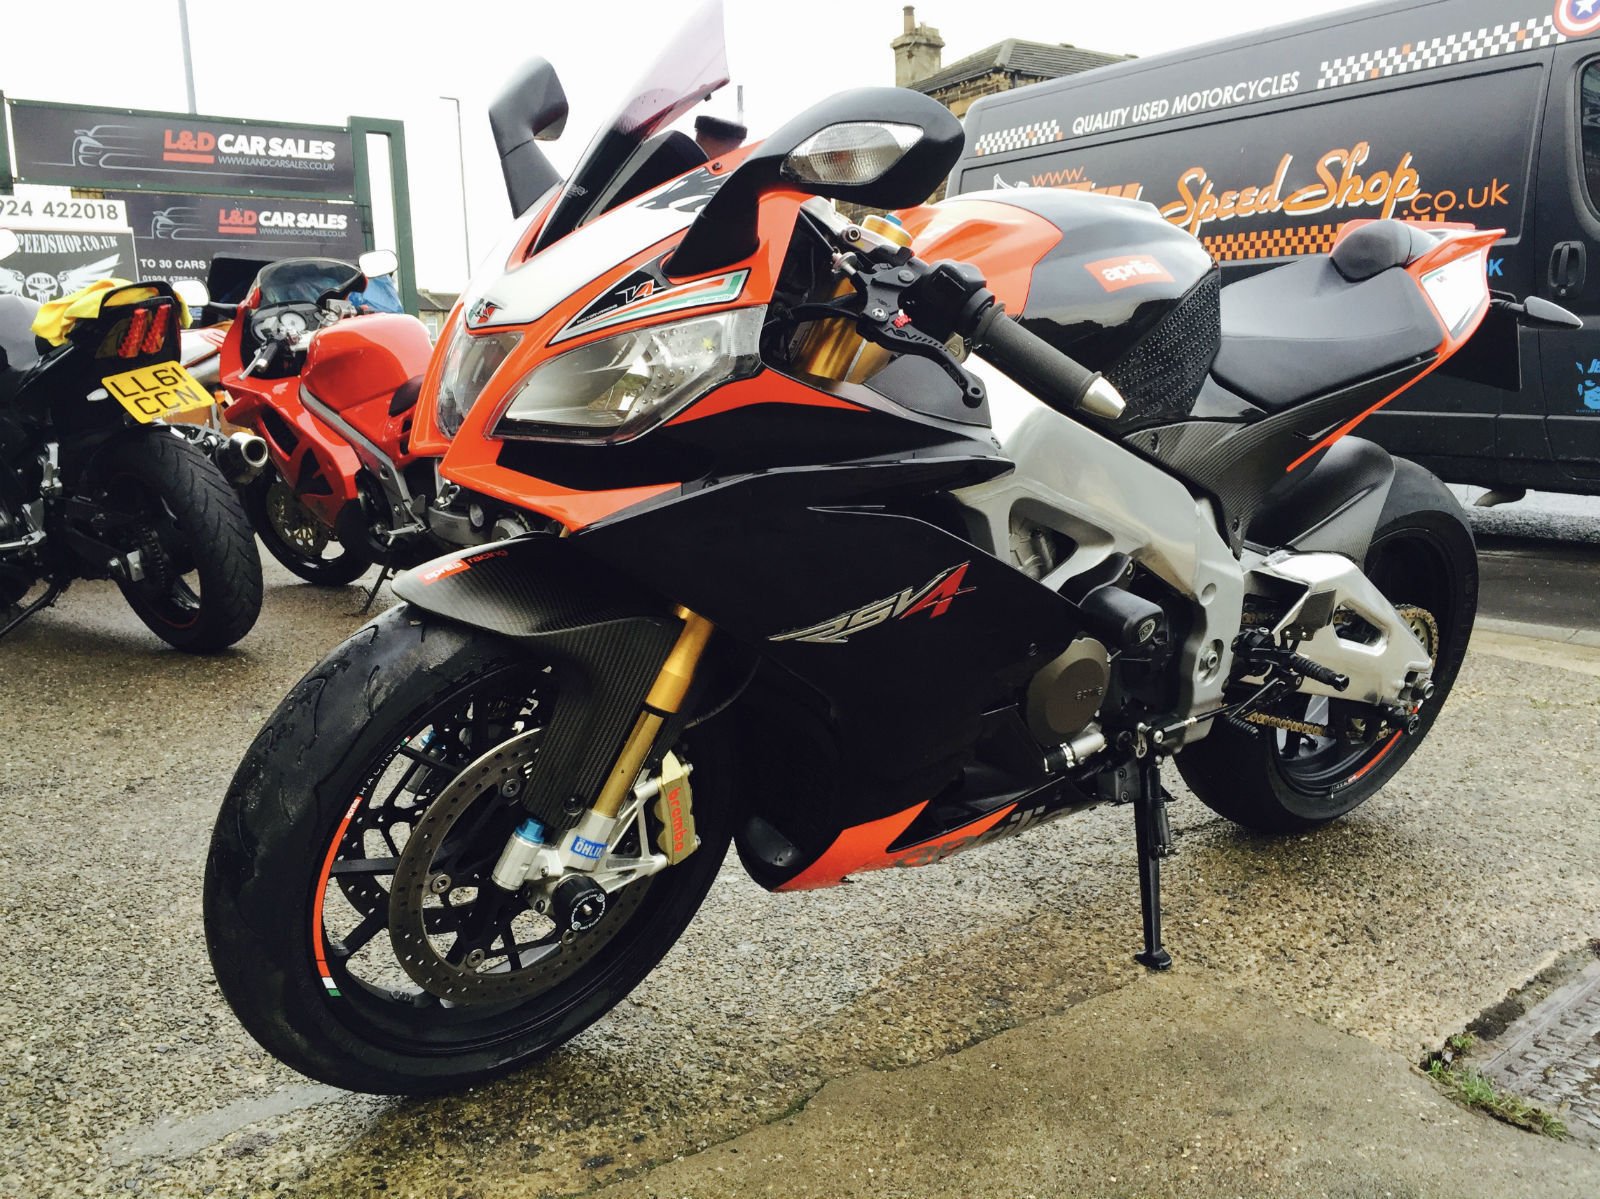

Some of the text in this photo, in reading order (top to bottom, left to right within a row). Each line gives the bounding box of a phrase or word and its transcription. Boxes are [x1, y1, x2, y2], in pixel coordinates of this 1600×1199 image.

[1072, 71, 1300, 135] QUALITY USED MOTORCYCLES
[163, 129, 336, 160] L&D CAR SALES
[218, 155, 335, 171] WWW.LANDCARSALES.CO.UK
[42, 201, 119, 220] 422018
[218, 209, 257, 225] L&D
[15, 233, 118, 254] PEEDSHOP.CO.UK
[140, 258, 206, 270] TO 30 CARS
[1101, 259, 1162, 281] aprilia
[110, 366, 187, 398] LL61
[134, 386, 202, 415] CCN
[668, 787, 685, 852] brembo
